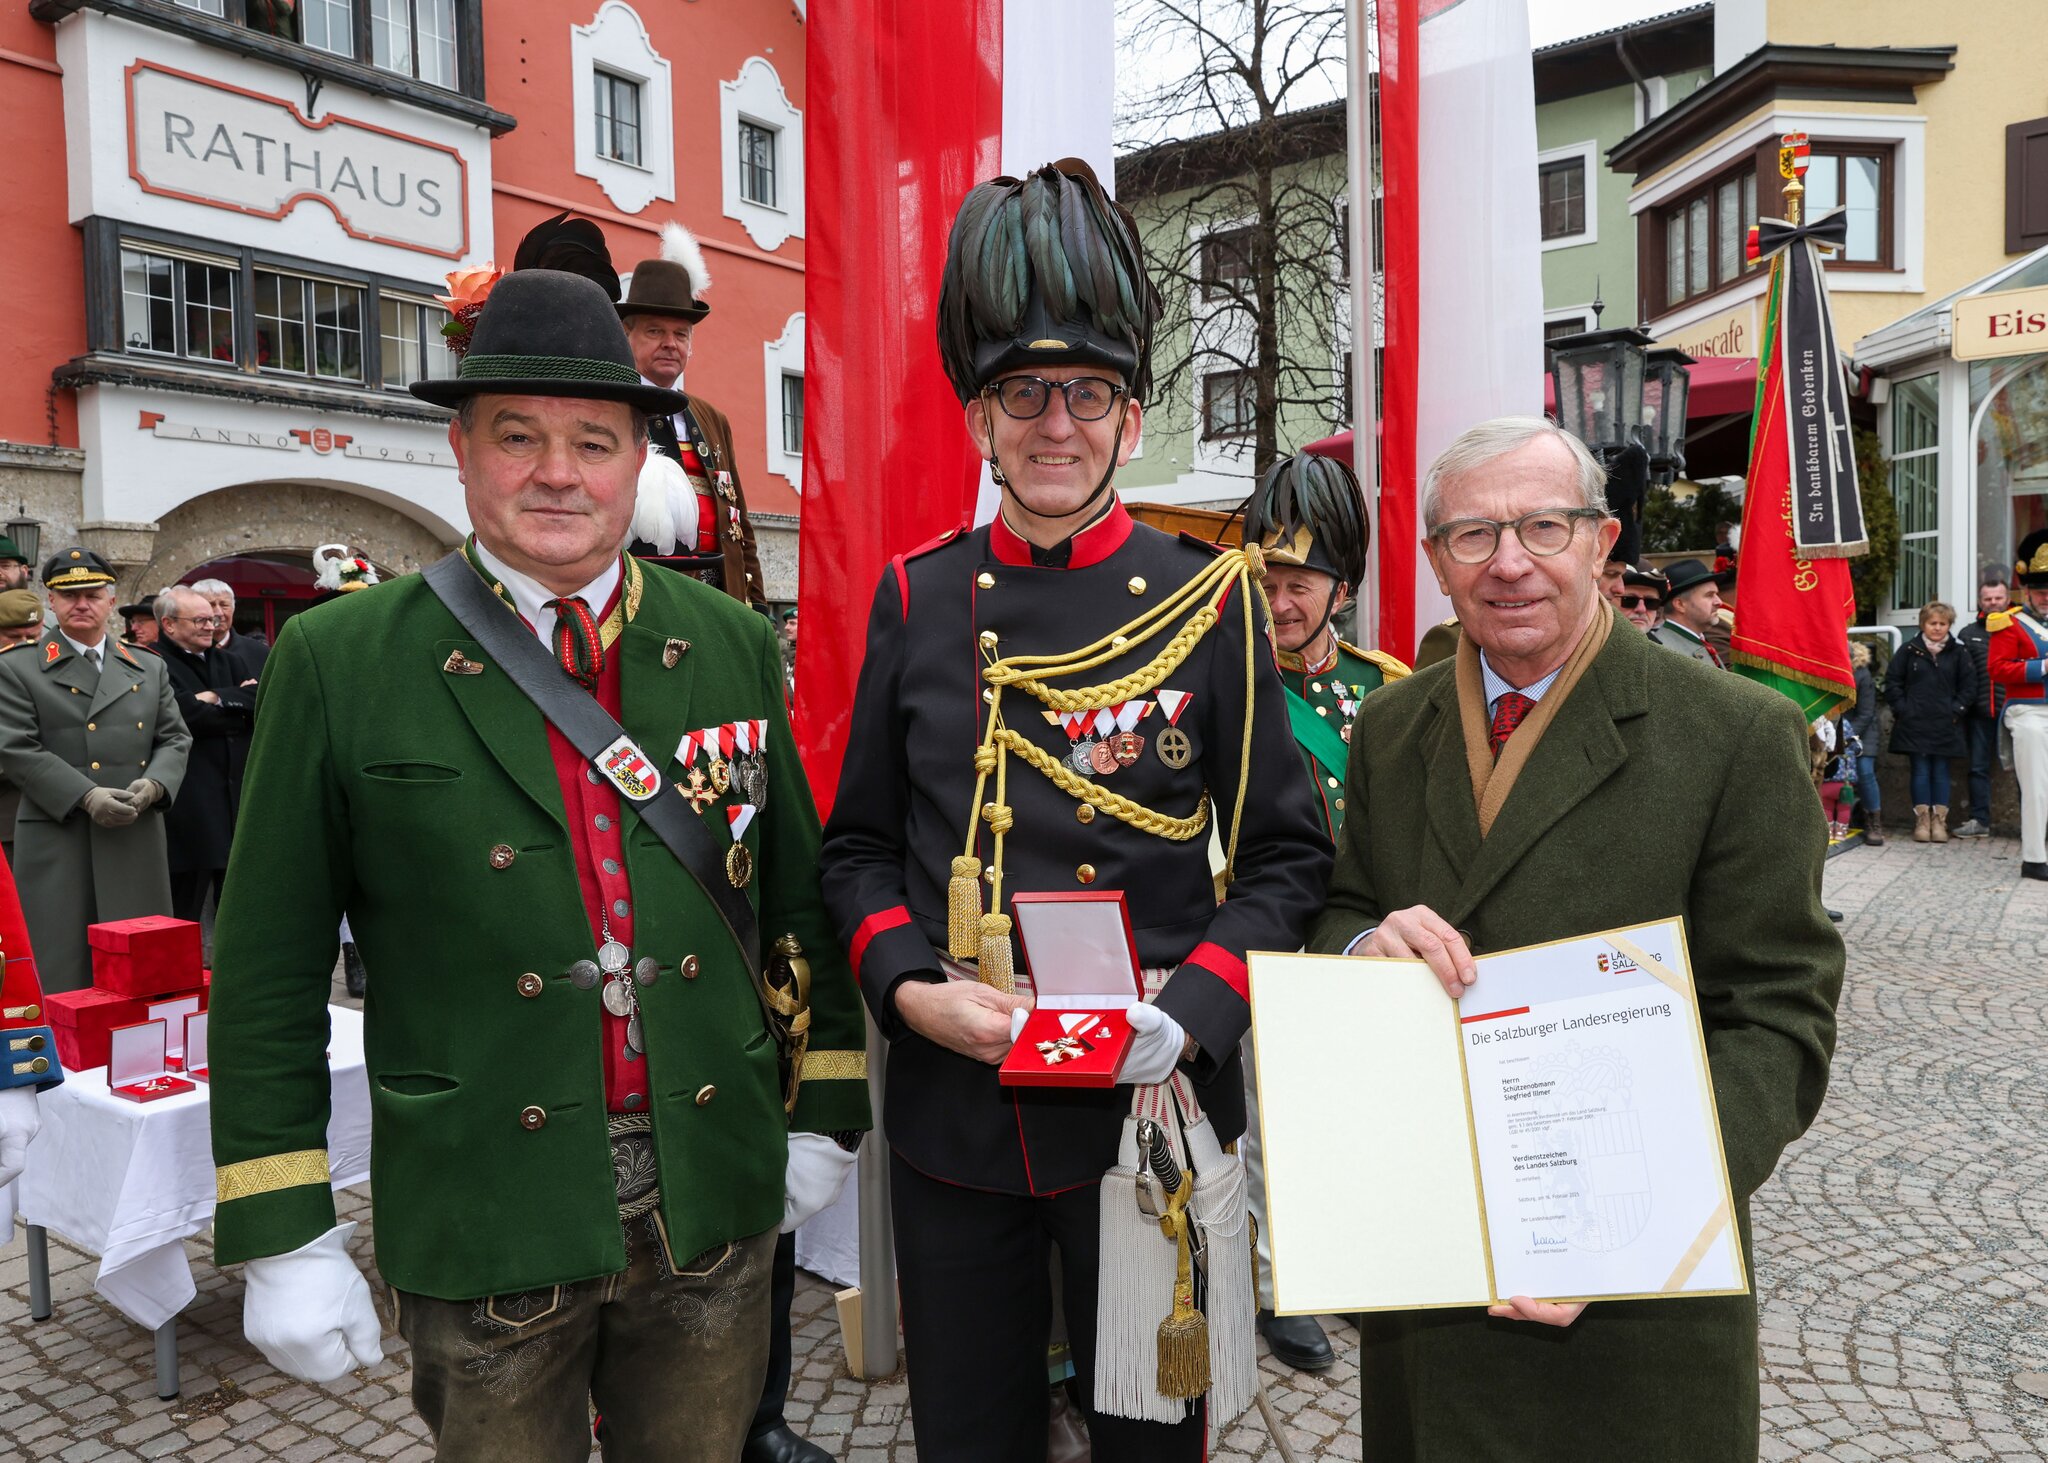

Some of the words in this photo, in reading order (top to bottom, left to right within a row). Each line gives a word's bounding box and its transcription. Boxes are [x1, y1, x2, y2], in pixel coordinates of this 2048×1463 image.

[163, 110, 442, 218] RATHAUS
[1988, 309, 2046, 338] Eis
[1800, 349, 1817, 418] Gedenken
[190, 427, 289, 449] ANNO
[356, 445, 437, 463] 1967
[1808, 502, 1824, 522] In
[1471, 1032, 1492, 1046] Die
[1494, 1021, 1559, 1042] Salzburger
[1562, 1003, 1672, 1031] Landesregierung
[1501, 1077, 1520, 1085] Herrn
[1504, 1092, 1532, 1101] Siegfried
[1512, 1151, 1568, 1163] Verdienstzeichen
[1526, 1161, 1549, 1170] Landes
[1549, 1158, 1578, 1167] Salzburg
